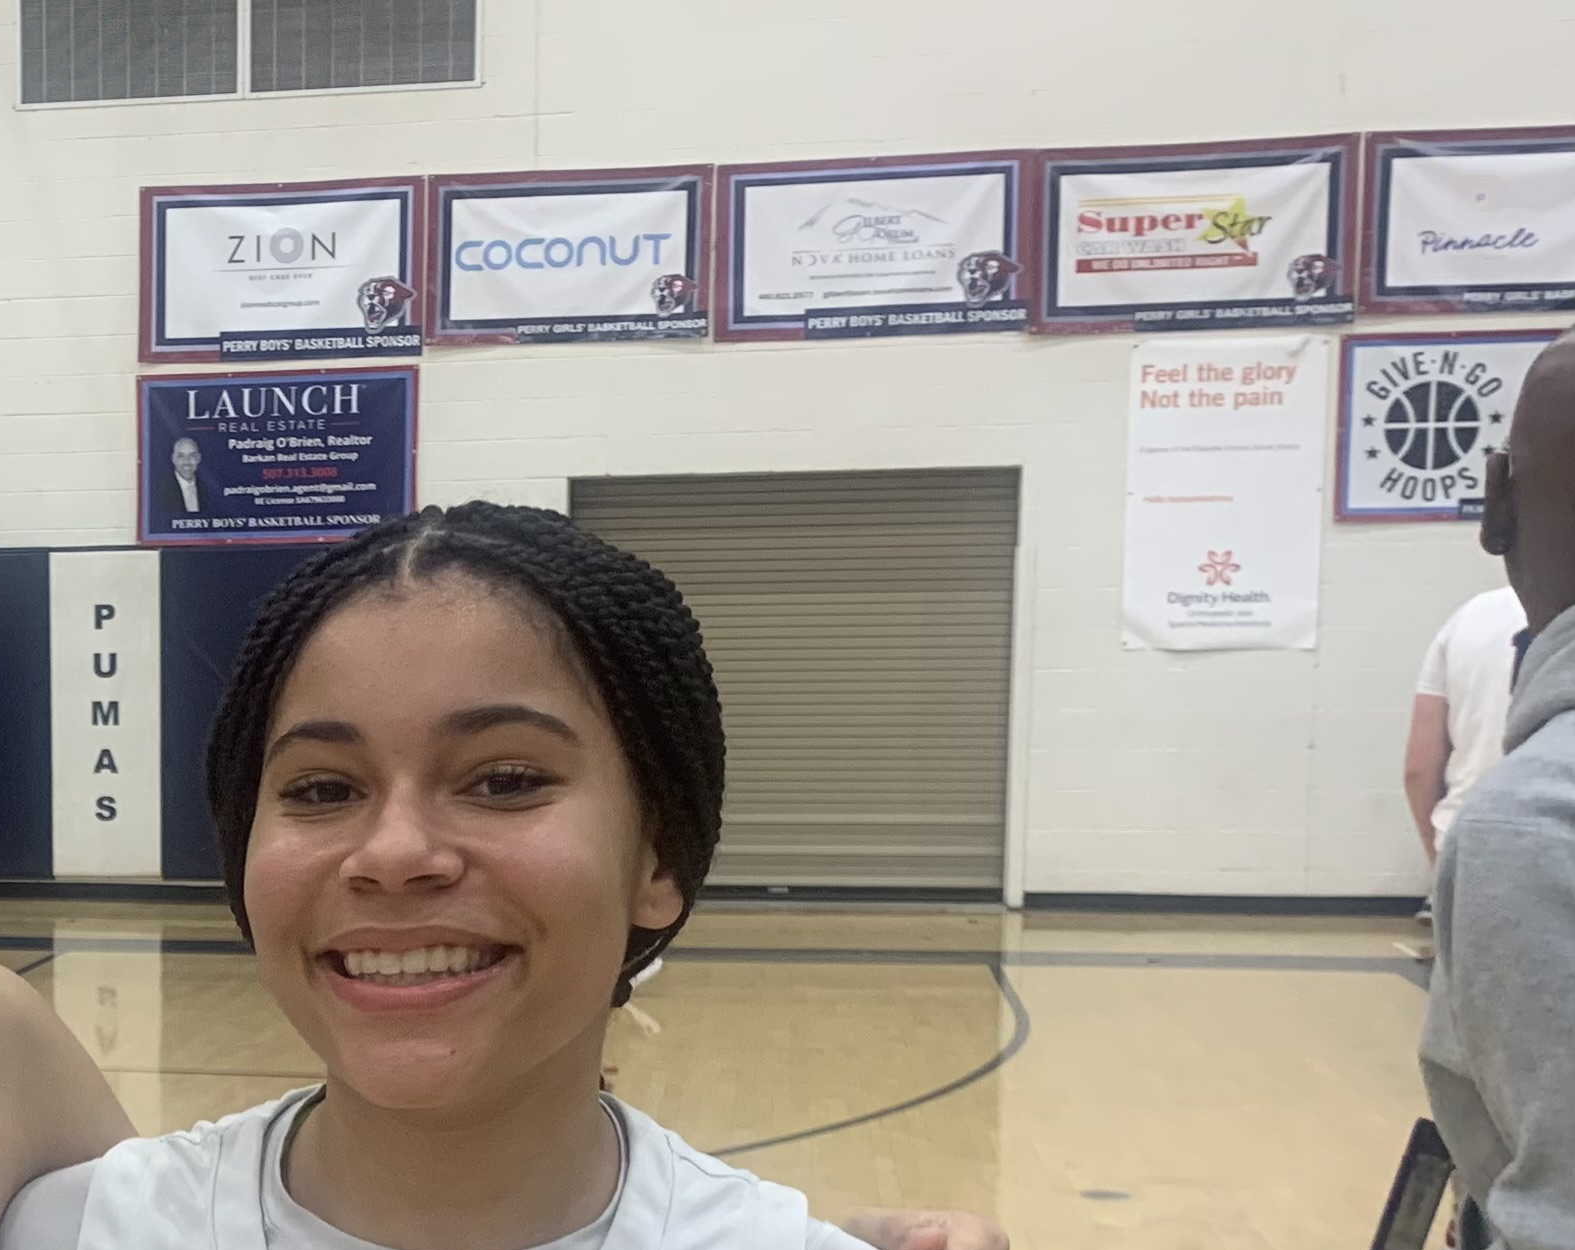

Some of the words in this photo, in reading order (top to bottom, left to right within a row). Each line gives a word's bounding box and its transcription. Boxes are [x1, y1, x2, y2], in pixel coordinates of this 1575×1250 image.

[1077, 210, 1204, 237] Super
[1205, 211, 1272, 244] Star
[227, 227, 337, 264] ZION
[1417, 227, 1540, 255] Pinnacle
[455, 233, 672, 272] COCONUT
[848, 251, 897, 264] HOME
[903, 248, 955, 262] LOANS
[1463, 291, 1501, 303] PERRY
[808, 316, 847, 329] PERRY
[849, 314, 886, 327] BOYS'
[887, 311, 965, 325] BASKETBALL
[966, 308, 1027, 322] SPONSOR
[1134, 311, 1173, 321] PERRY
[1214, 306, 1293, 319] BASKETBALL
[1295, 303, 1354, 315] SPONSOR
[516, 324, 552, 335] PERRY
[552, 323, 586, 334] GIRLS'
[587, 321, 656, 332] BASKETBALL
[657, 318, 707, 330] SPONSOR
[223, 340, 259, 353] PERRY
[260, 339, 293, 351] BOYS'
[294, 337, 365, 350] BASKETBALL
[366, 335, 421, 348] SPONSOR
[1141, 364, 1188, 384] Feel
[1197, 363, 1234, 383] the
[1241, 361, 1297, 385] glory
[186, 383, 361, 420] LAUNCH
[1140, 390, 1180, 409] Not
[1189, 389, 1226, 408] the
[1233, 389, 1284, 411] pain
[217, 421, 260, 433] REAL
[266, 419, 326, 432] ESTATE
[228, 437, 274, 451] Padraig
[327, 434, 373, 446] Realtor
[276, 453, 297, 461] Real
[298, 453, 328, 461] Estate
[328, 451, 359, 462] Group
[1379, 467, 1479, 502] HOOPS
[172, 519, 210, 530] PERRY
[212, 517, 247, 529] BOYS'
[248, 515, 325, 528] BASKETBALL
[326, 514, 381, 526] SPONSOR
[1167, 591, 1217, 608] Dignity
[91, 604, 120, 822] PUMAS
